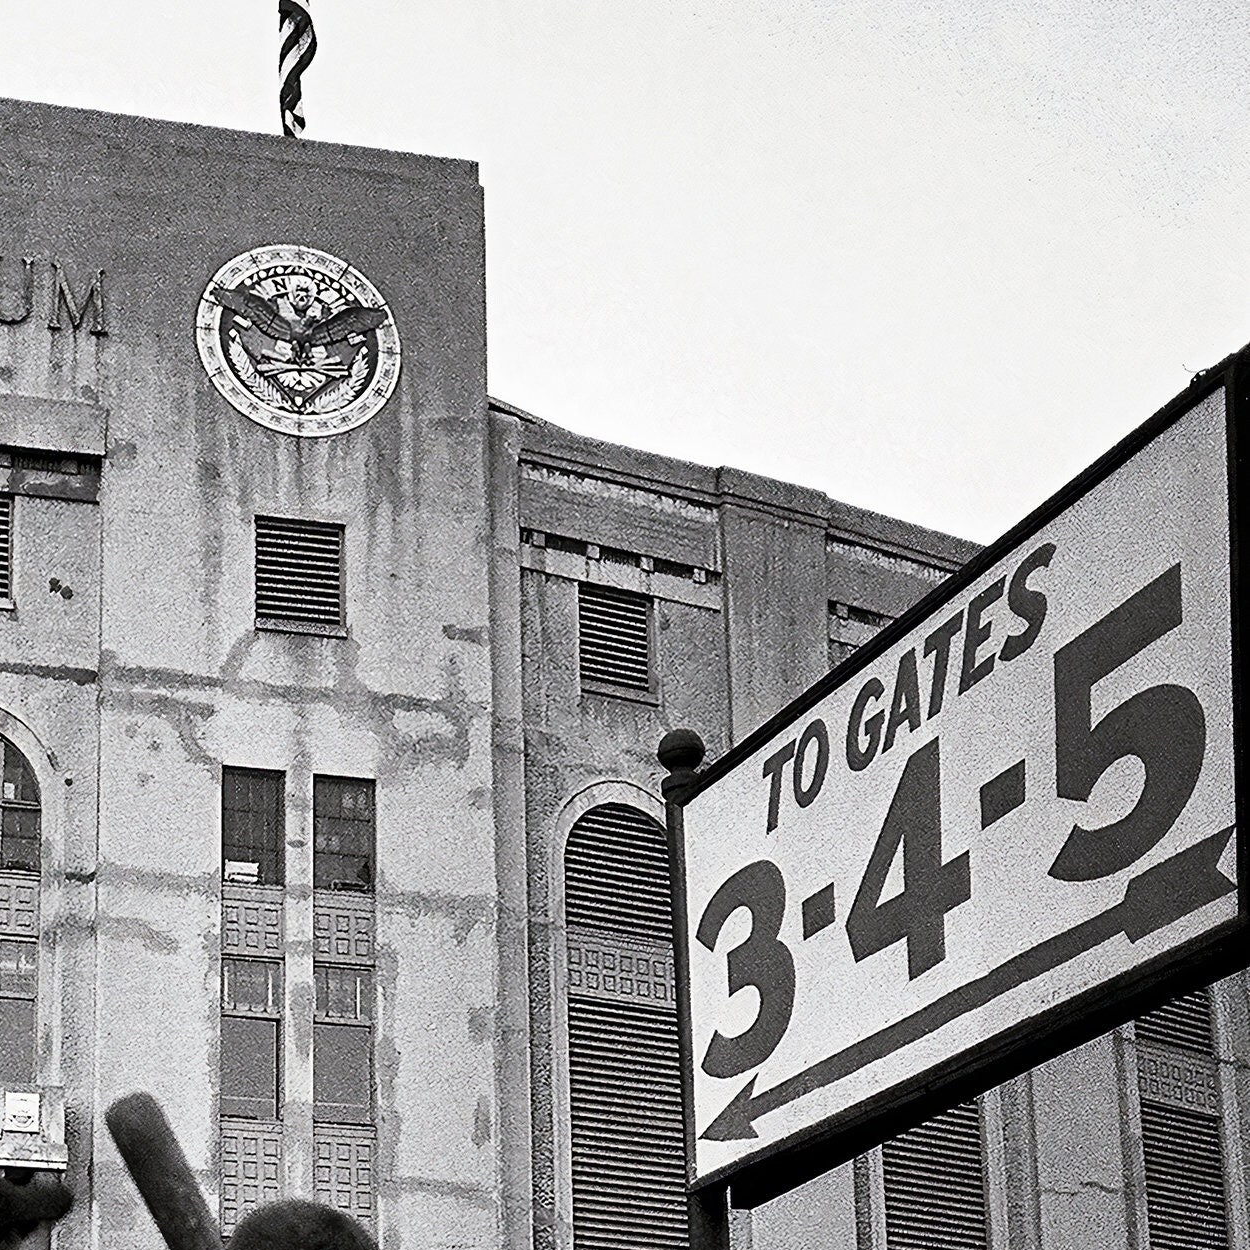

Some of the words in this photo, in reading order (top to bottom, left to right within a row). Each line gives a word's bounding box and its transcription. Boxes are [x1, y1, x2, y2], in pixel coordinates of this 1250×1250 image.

[696, 561, 1206, 1079] 3-4-5
[762, 718, 830, 834] TO
[846, 543, 1056, 771] GATES
